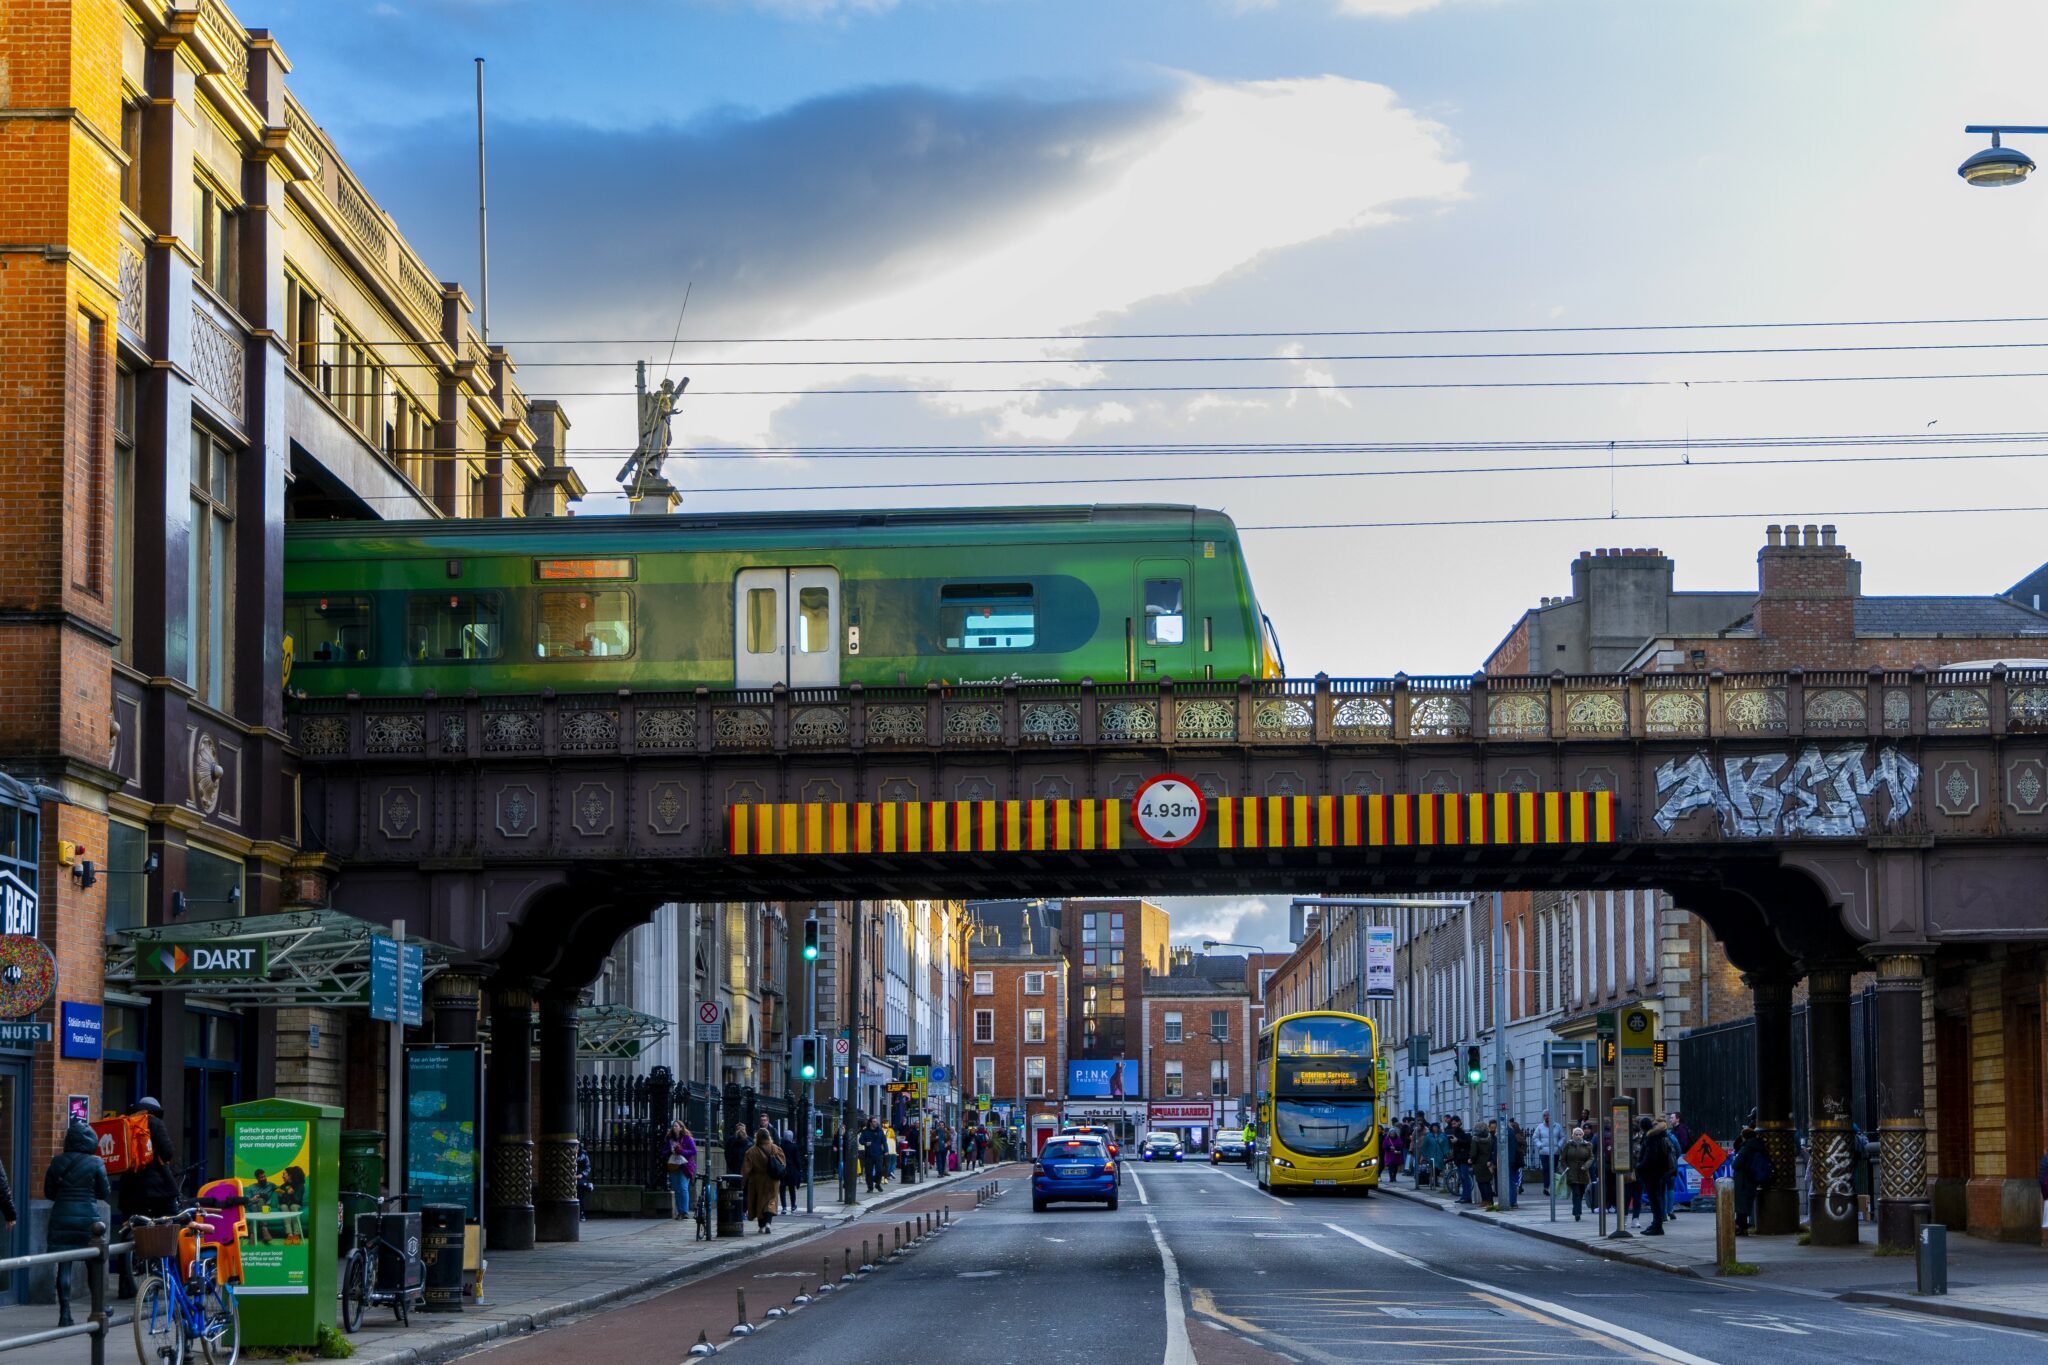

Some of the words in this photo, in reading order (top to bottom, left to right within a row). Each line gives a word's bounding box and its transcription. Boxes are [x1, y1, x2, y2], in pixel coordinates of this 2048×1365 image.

[1141, 803, 1197, 818] 4.93m
[5, 884, 34, 935] BEAT
[193, 949, 256, 970] DART
[1, 1025, 41, 1040] NUTS
[84, 1034, 96, 1045] Station
[1076, 1070, 1109, 1079] P!NK
[1180, 1107, 1210, 1117] BARBERS
